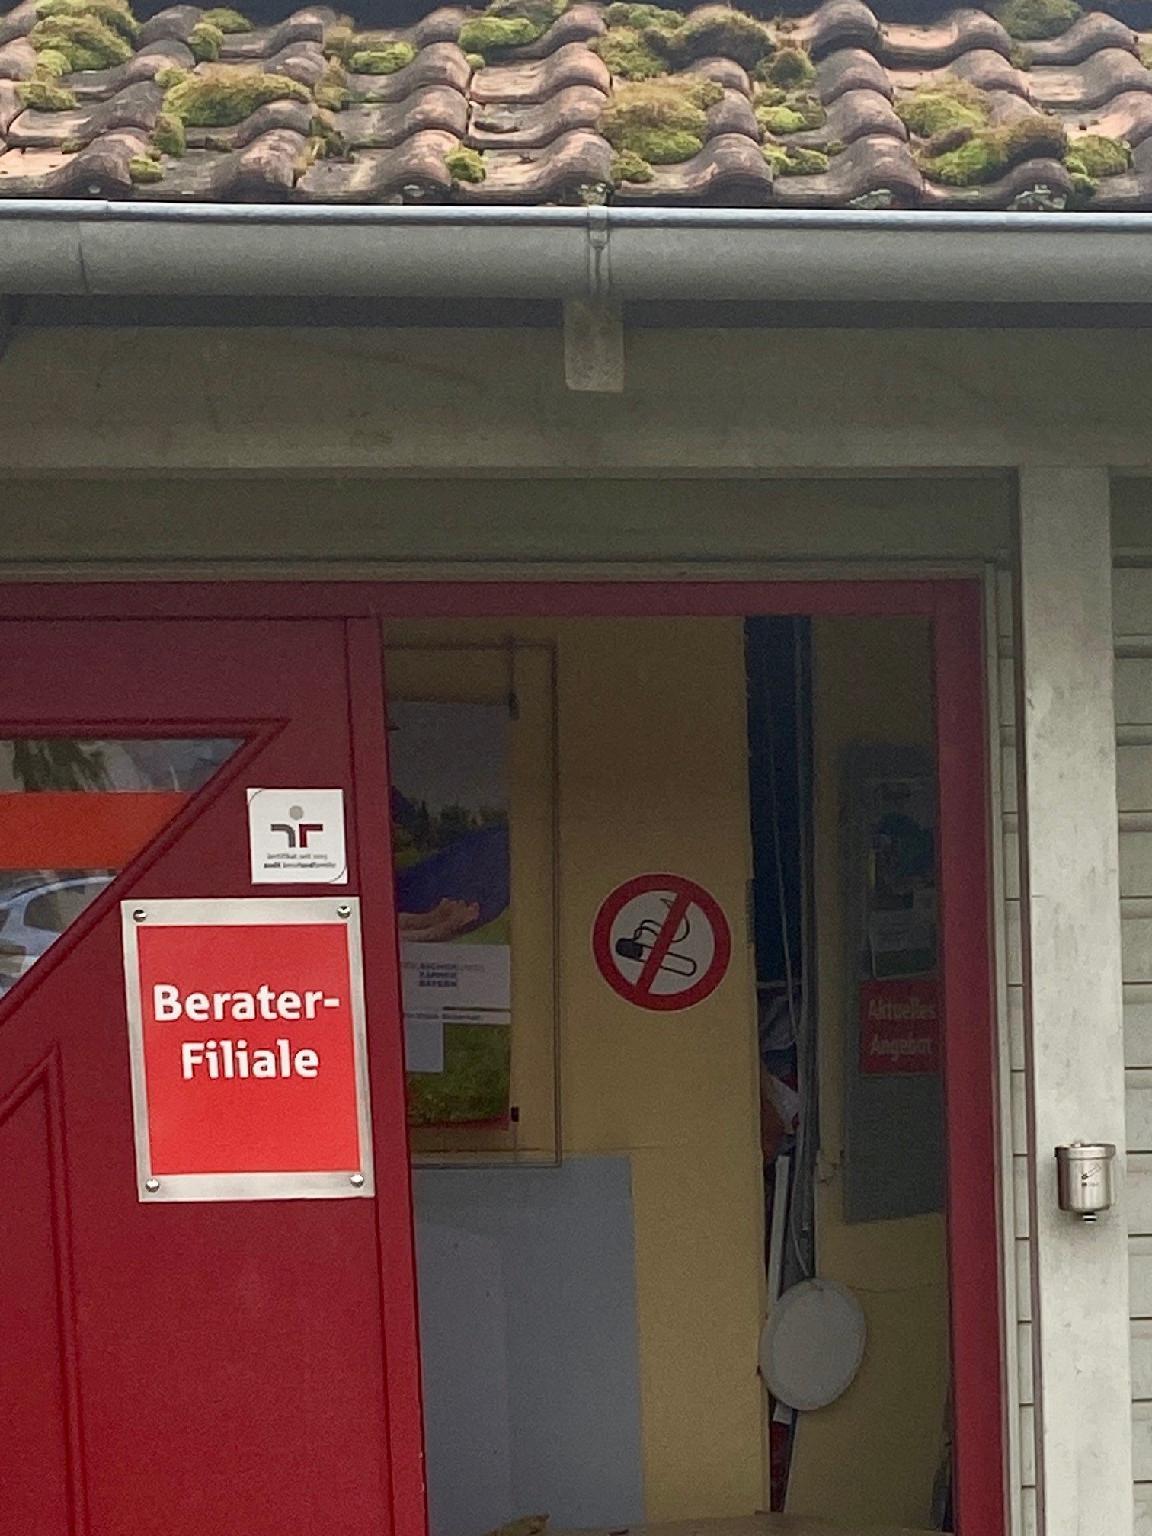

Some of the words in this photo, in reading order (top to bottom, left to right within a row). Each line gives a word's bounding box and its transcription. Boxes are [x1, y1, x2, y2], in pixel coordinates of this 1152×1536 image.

[153, 983, 341, 1021] Berater-
[868, 998, 937, 1020] Aktuelles
[181, 1038, 320, 1080] Filiale
